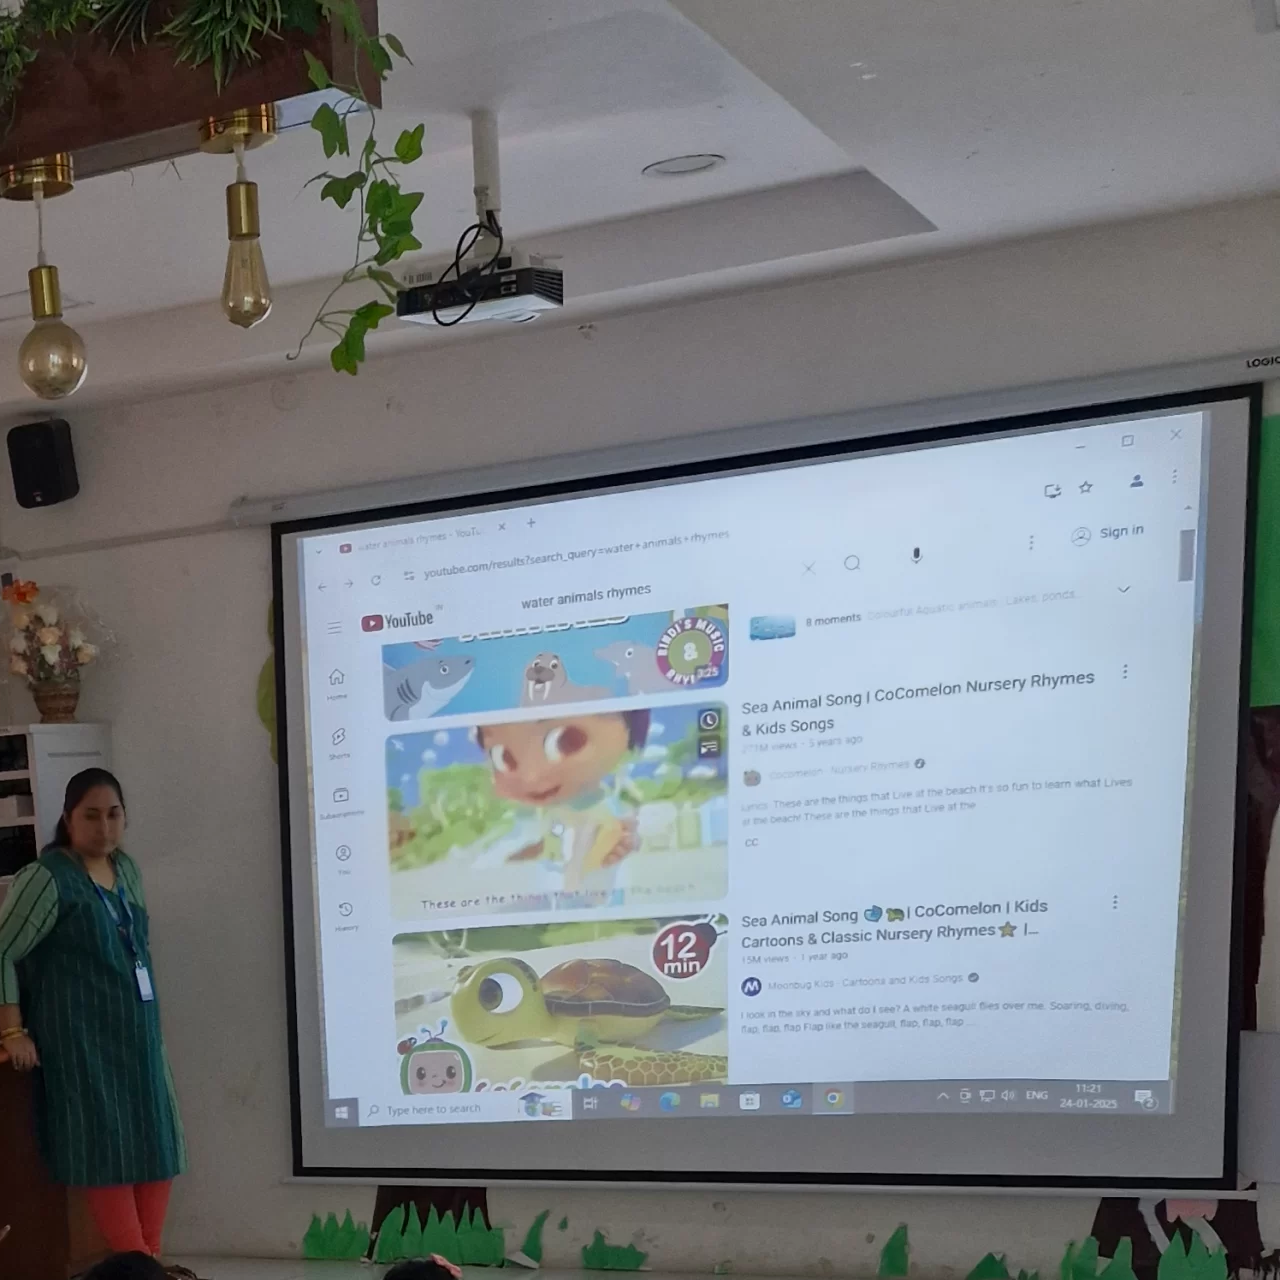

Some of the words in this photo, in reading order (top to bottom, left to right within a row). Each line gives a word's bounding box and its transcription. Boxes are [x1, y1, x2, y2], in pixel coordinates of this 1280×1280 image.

[1100, 526, 1128, 542] Sign
[1131, 523, 1144, 536] in
[521, 595, 554, 609] water
[557, 588, 604, 605] animals
[606, 584, 652, 601] rhymes
[384, 610, 434, 630] YouTube
[815, 612, 862, 626] moments
[694, 618, 725, 653] MUSIC
[742, 699, 768, 715] Sea
[772, 693, 822, 713] Animal
[826, 690, 862, 710] Song
[875, 681, 962, 703] CoComelon
[966, 675, 1027, 696] Nursery
[1030, 670, 1095, 691] Rhymes
[741, 724, 752, 738] &
[756, 719, 787, 736] Kids
[790, 716, 835, 735] Songs
[821, 796, 836, 805] the
[838, 793, 868, 805] things
[871, 791, 890, 801] that
[892, 789, 912, 799] Live
[927, 787, 943, 797] the
[945, 783, 977, 796] beach
[1011, 781, 1029, 792] fun
[1031, 780, 1043, 790] to
[1044, 779, 1071, 789] learn
[1074, 777, 1101, 788] what
[1104, 776, 1134, 788] Lives
[804, 810, 832, 821] These
[834, 810, 849, 819] are
[851, 807, 867, 818] the
[870, 805, 900, 818] things
[902, 804, 922, 815] that
[924, 802, 945, 813] Live
[960, 800, 976, 810] the
[745, 837, 759, 848] CC
[421, 898, 457, 912] These
[461, 898, 480, 908] are
[486, 894, 505, 905] the
[741, 915, 767, 928] Sea
[771, 911, 818, 927] Animal
[822, 909, 858, 925] Song
[915, 901, 1001, 918] CoComelon
[1014, 899, 1048, 914] Kids
[741, 936, 804, 949] Cartoons
[807, 933, 818, 946] &
[821, 930, 872, 944] Classic
[876, 927, 932, 943] Nursery
[937, 924, 996, 941] Rhymes
[660, 932, 696, 960] 12
[830, 951, 848, 962] ago
[663, 958, 700, 976] min
[888, 975, 906, 986] and
[932, 973, 964, 985] Songs
[813, 1007, 831, 1017] and
[833, 1005, 856, 1016] what
[858, 1004, 870, 1014] do
[878, 1003, 900, 1014] see?
[902, 1003, 910, 1013] A
[1002, 1002, 1024, 1011] over
[1026, 1090, 1048, 1100] ENG
[1075, 1083, 1101, 1093] 11:21
[387, 1105, 409, 1117] Type
[412, 1105, 434, 1115] here
[436, 1105, 447, 1114] to
[449, 1104, 481, 1113] search
[1059, 1098, 1117, 1109] 24-01-2025
